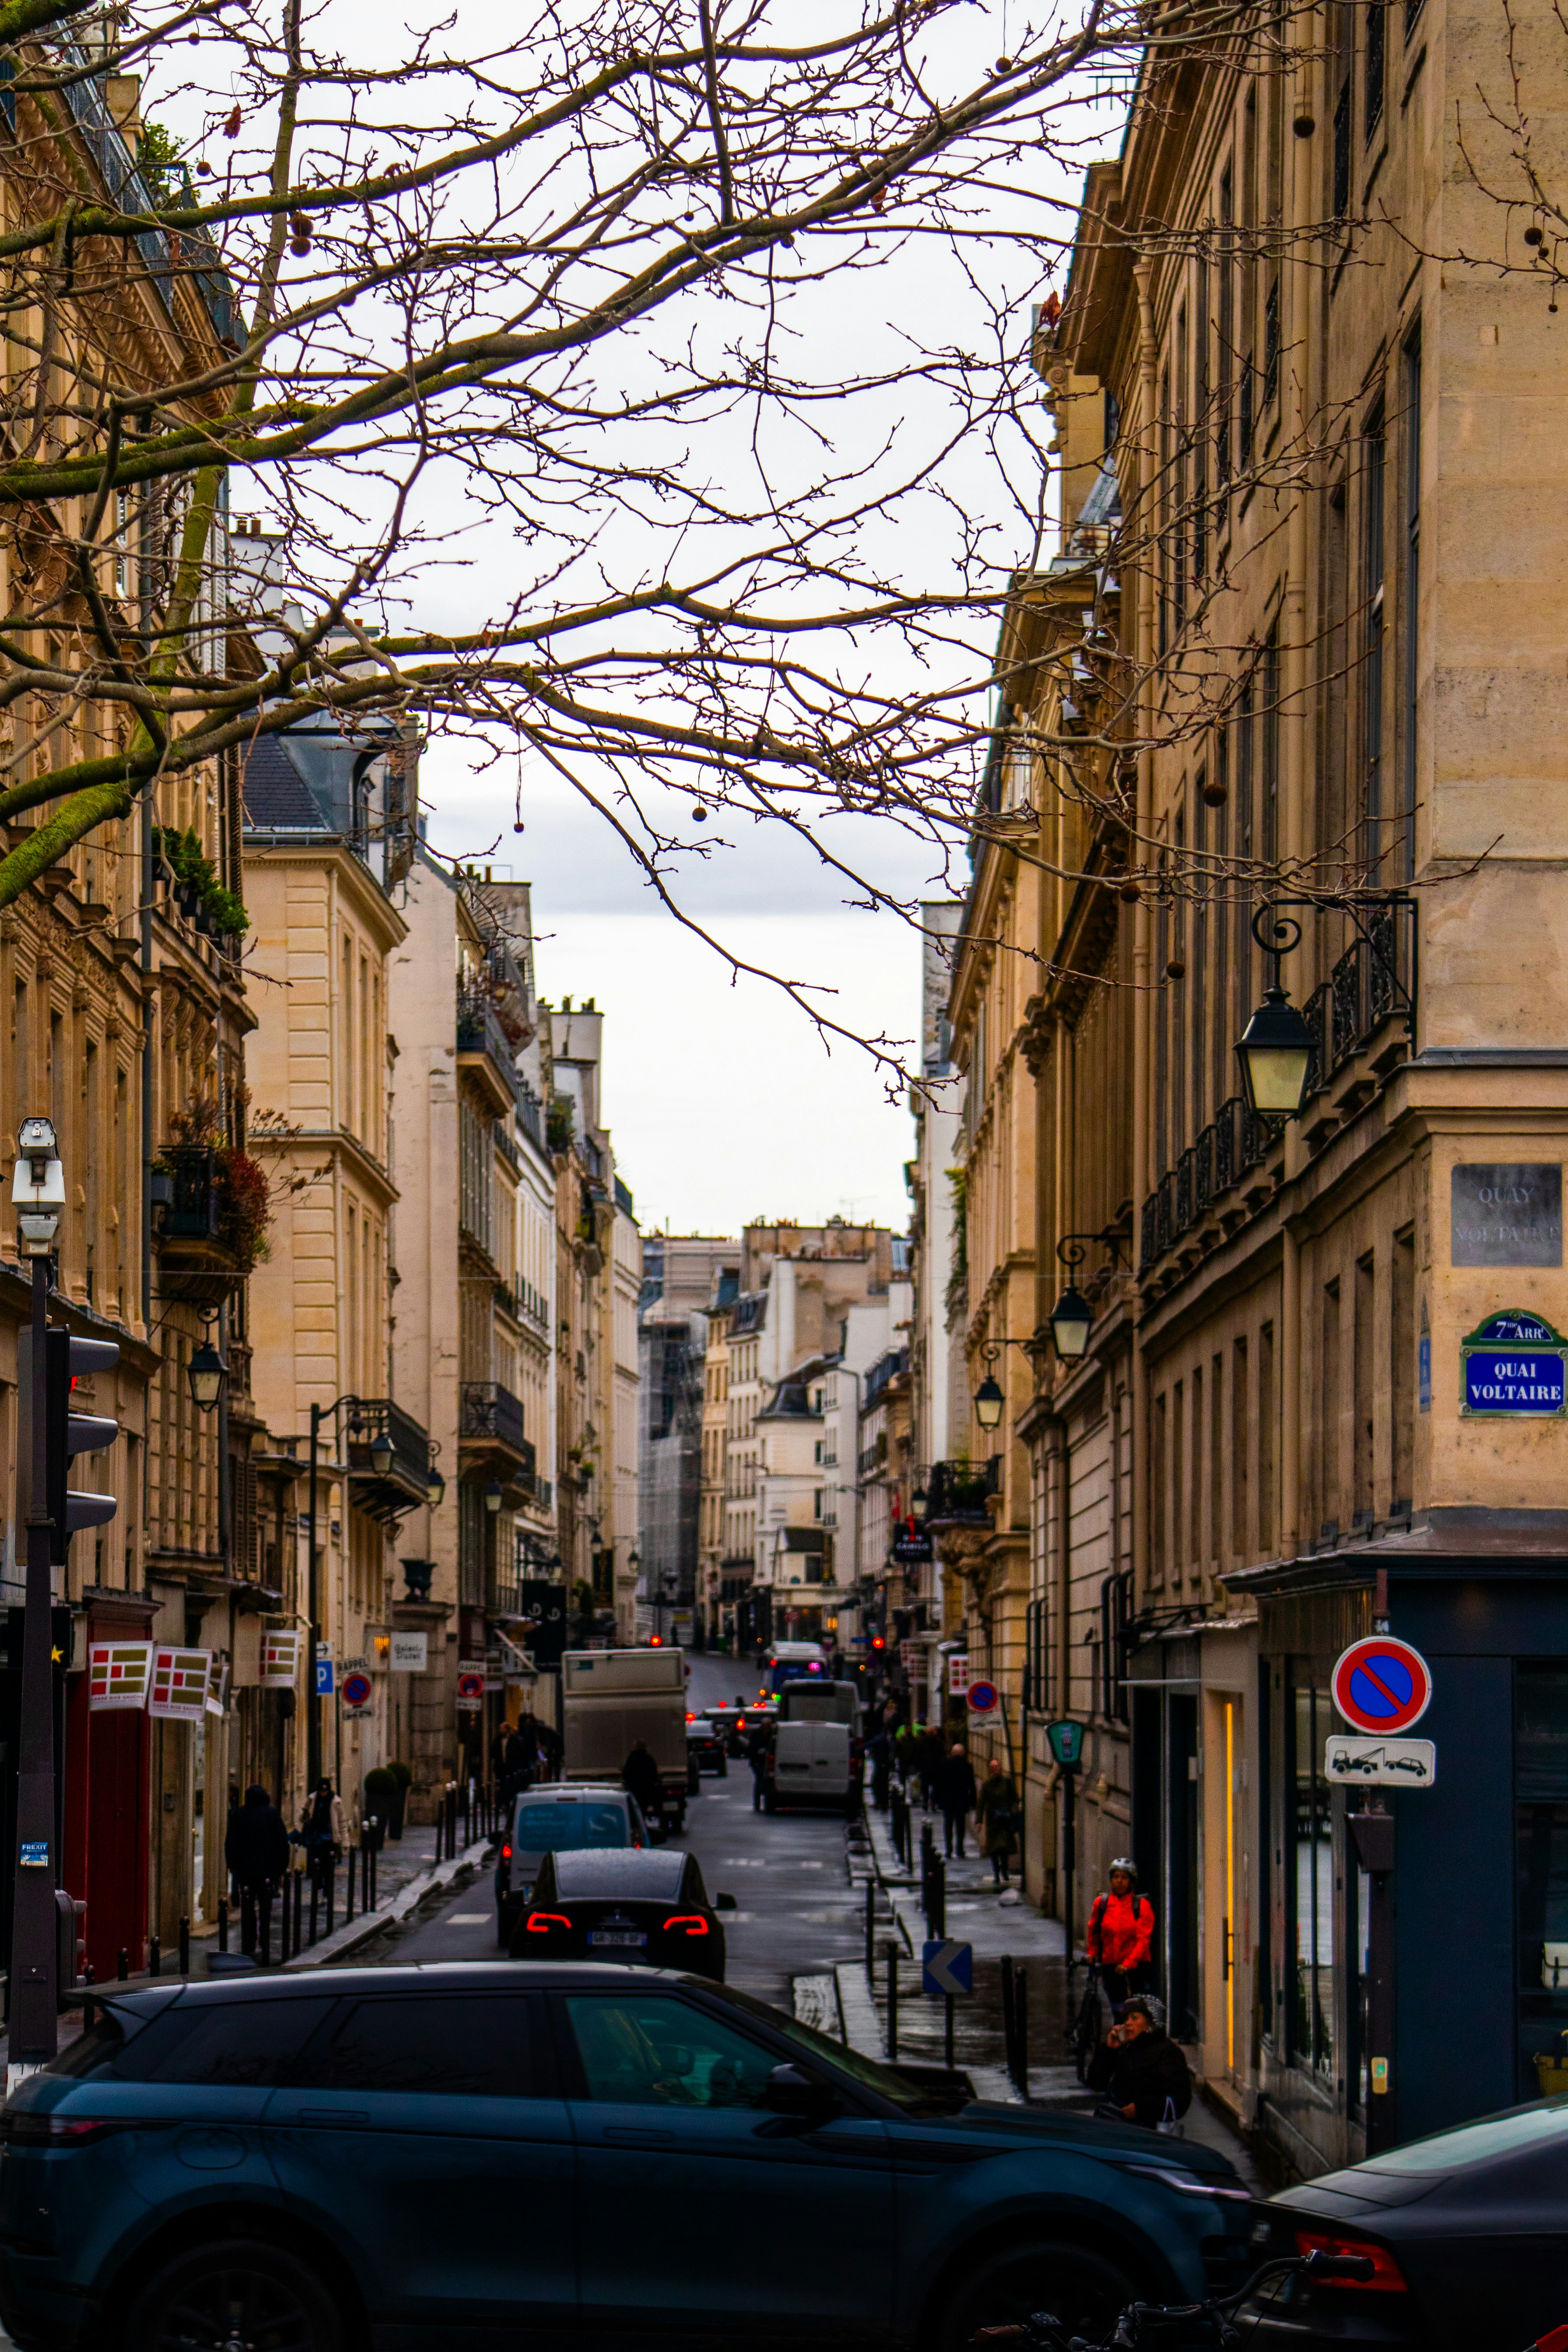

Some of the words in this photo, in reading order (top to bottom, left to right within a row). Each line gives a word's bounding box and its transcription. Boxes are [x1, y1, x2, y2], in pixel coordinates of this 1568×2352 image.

[1478, 1187, 1535, 1209] QUAY
[1494, 1363, 1536, 1380] QUAI
[1470, 1384, 1561, 1400] VOLTAIRE
[337, 1658, 369, 1672] RAPPEL
[459, 1662, 485, 1671] RAPPEL
[317, 1667, 327, 1687] P
